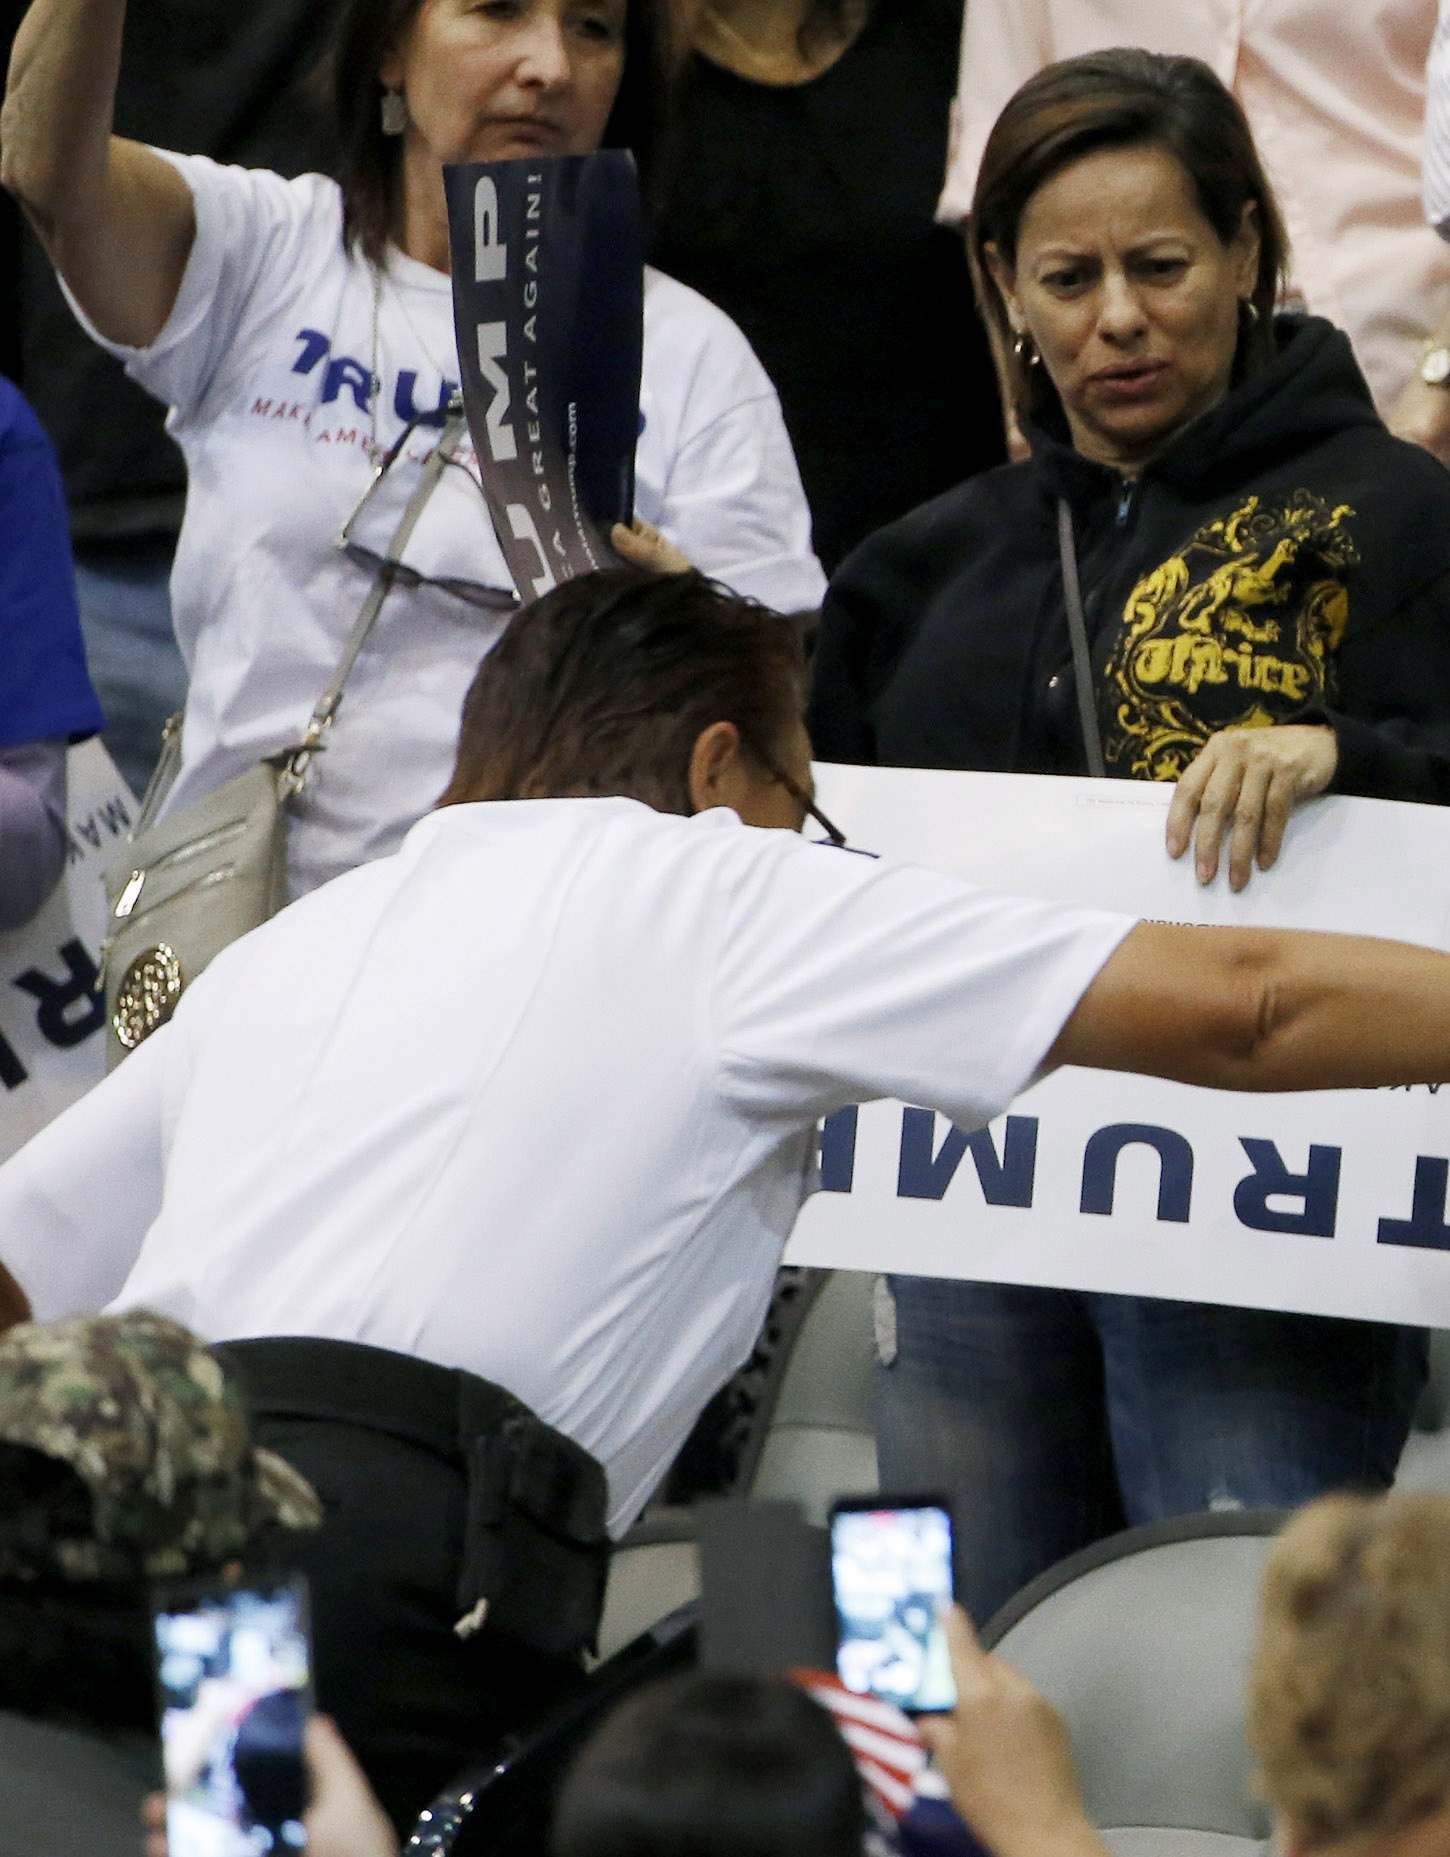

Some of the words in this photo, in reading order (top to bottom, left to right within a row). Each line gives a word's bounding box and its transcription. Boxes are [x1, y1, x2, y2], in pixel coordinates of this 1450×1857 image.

[523, 174, 542, 342] AGAIN!
[291, 328, 457, 428] TRU
[474, 175, 558, 598] UMP
[524, 361, 551, 511] GREAT
